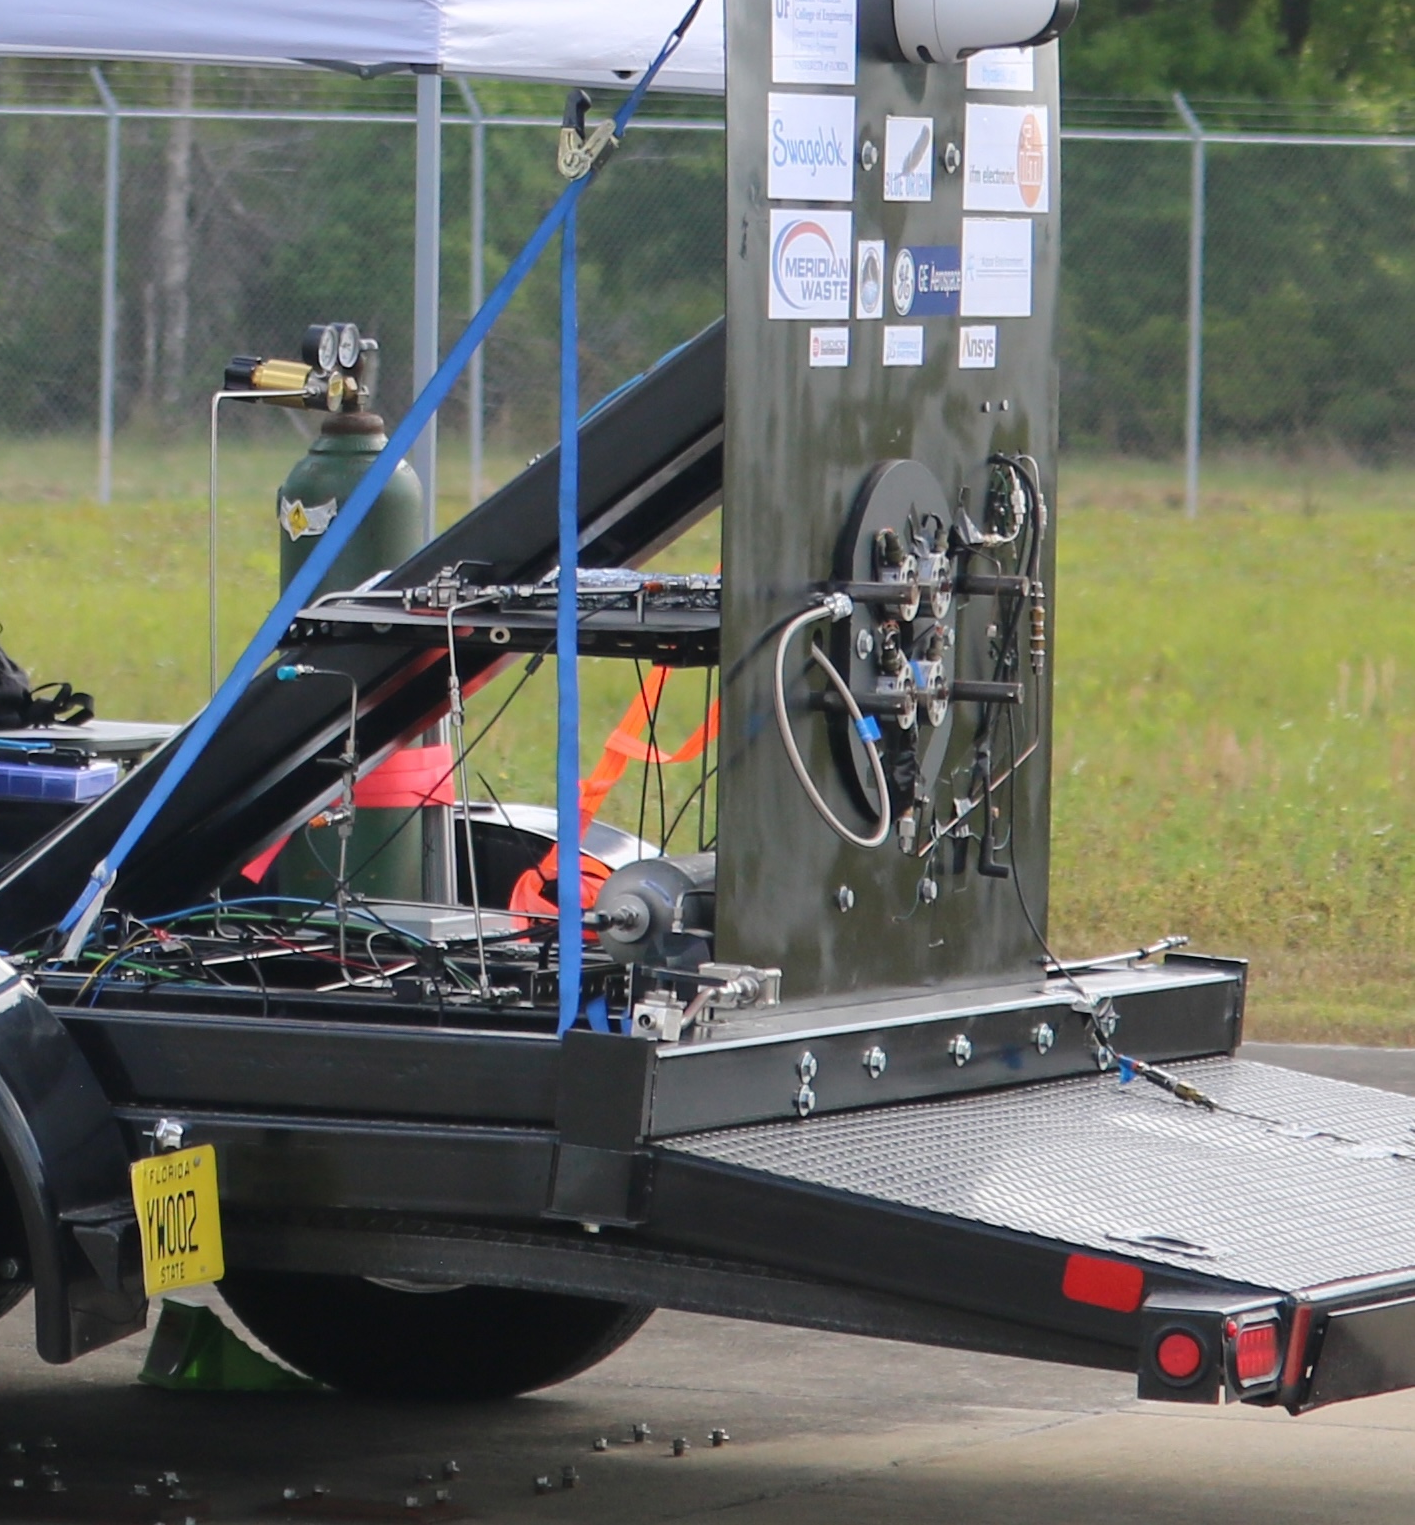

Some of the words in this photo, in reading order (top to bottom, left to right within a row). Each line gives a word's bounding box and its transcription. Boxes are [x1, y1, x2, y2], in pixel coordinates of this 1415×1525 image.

[772, 118, 847, 176] Swagelok
[982, 164, 1016, 185] electronic
[785, 257, 849, 278] MERIDIAN
[918, 264, 929, 293] GE
[801, 280, 848, 301] WASTE
[962, 331, 994, 364] Ansys
[149, 1160, 191, 1186] FLORIDA
[160, 1261, 185, 1284] STATE
